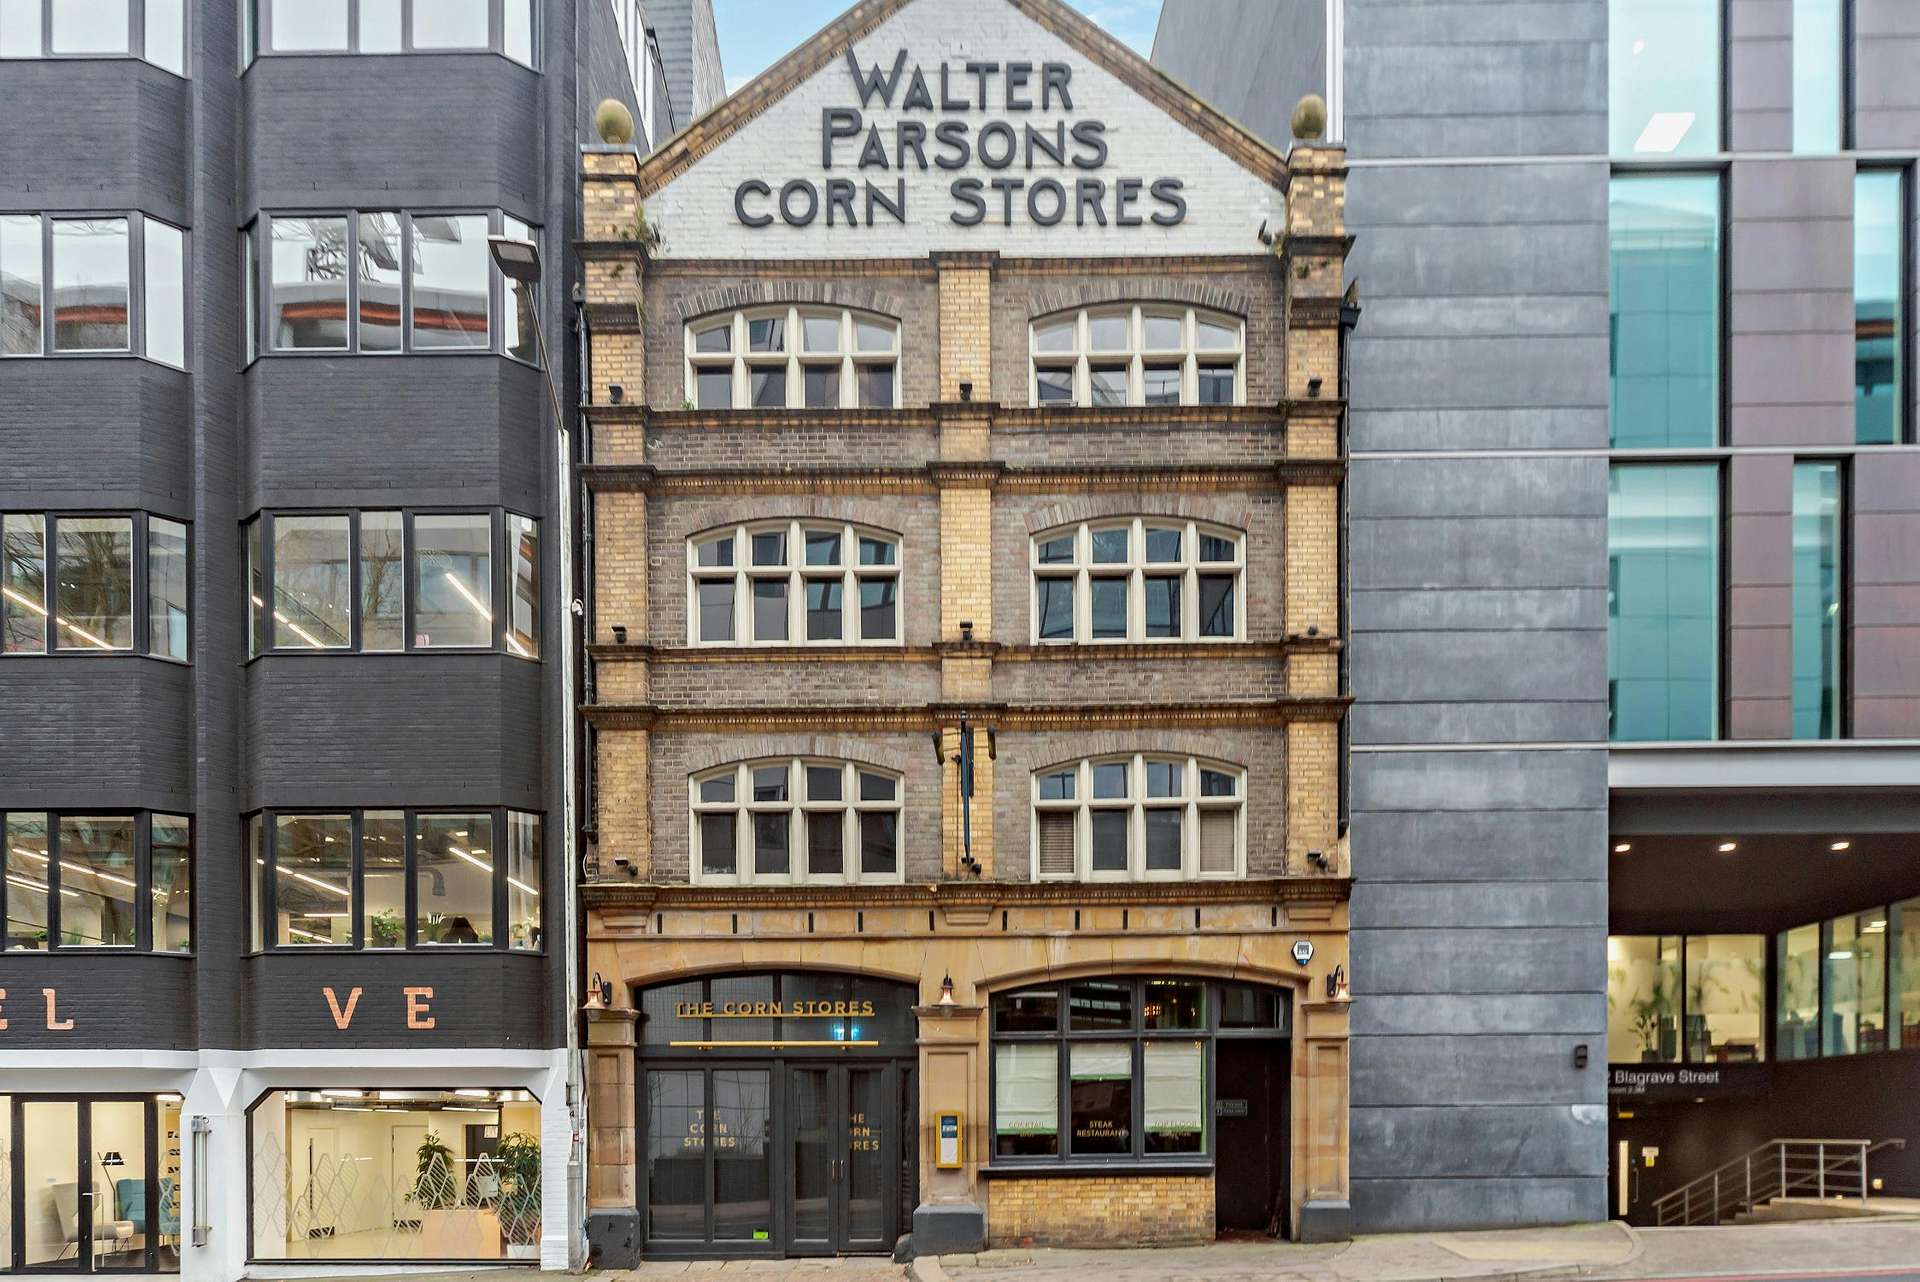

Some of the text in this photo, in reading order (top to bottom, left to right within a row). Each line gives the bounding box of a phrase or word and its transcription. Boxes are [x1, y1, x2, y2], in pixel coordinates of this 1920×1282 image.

[844, 48, 1074, 111] WALTER
[821, 107, 1108, 170] PARSONS
[734, 177, 1188, 228] CORN STORES
[674, 1000, 874, 1015] THE CORN STORES
[1615, 1069, 1676, 1086] Blagrave
[1679, 1069, 1720, 1084] Street
[695, 1109, 721, 1121] TE
[848, 1113, 865, 1124] HE
[1089, 1120, 1113, 1129] STEAK
